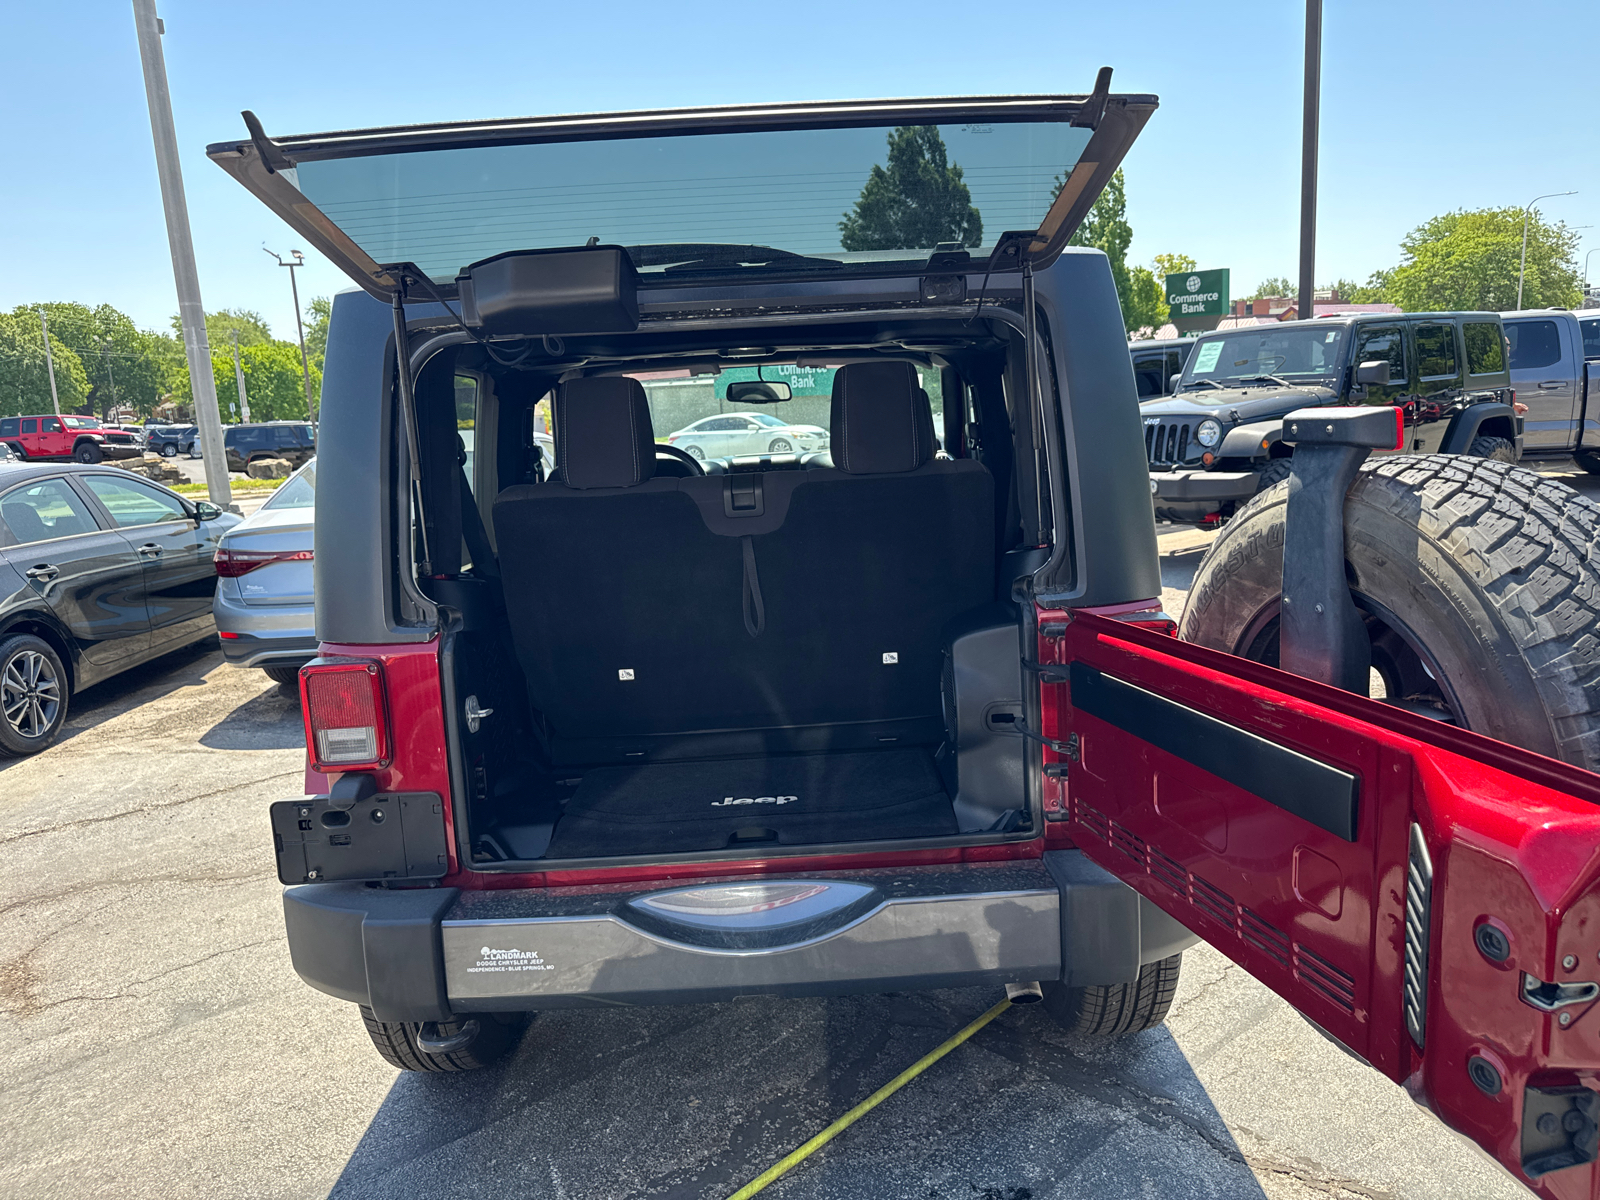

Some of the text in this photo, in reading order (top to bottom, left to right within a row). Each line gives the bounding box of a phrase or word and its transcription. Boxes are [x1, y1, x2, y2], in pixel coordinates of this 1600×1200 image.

[1169, 292, 1219, 304] Commerce
[1181, 302, 1205, 313] Bank
[791, 375, 815, 388] Bank
[711, 796, 798, 806] Jeep
[490, 951, 539, 960] LANDMARK
